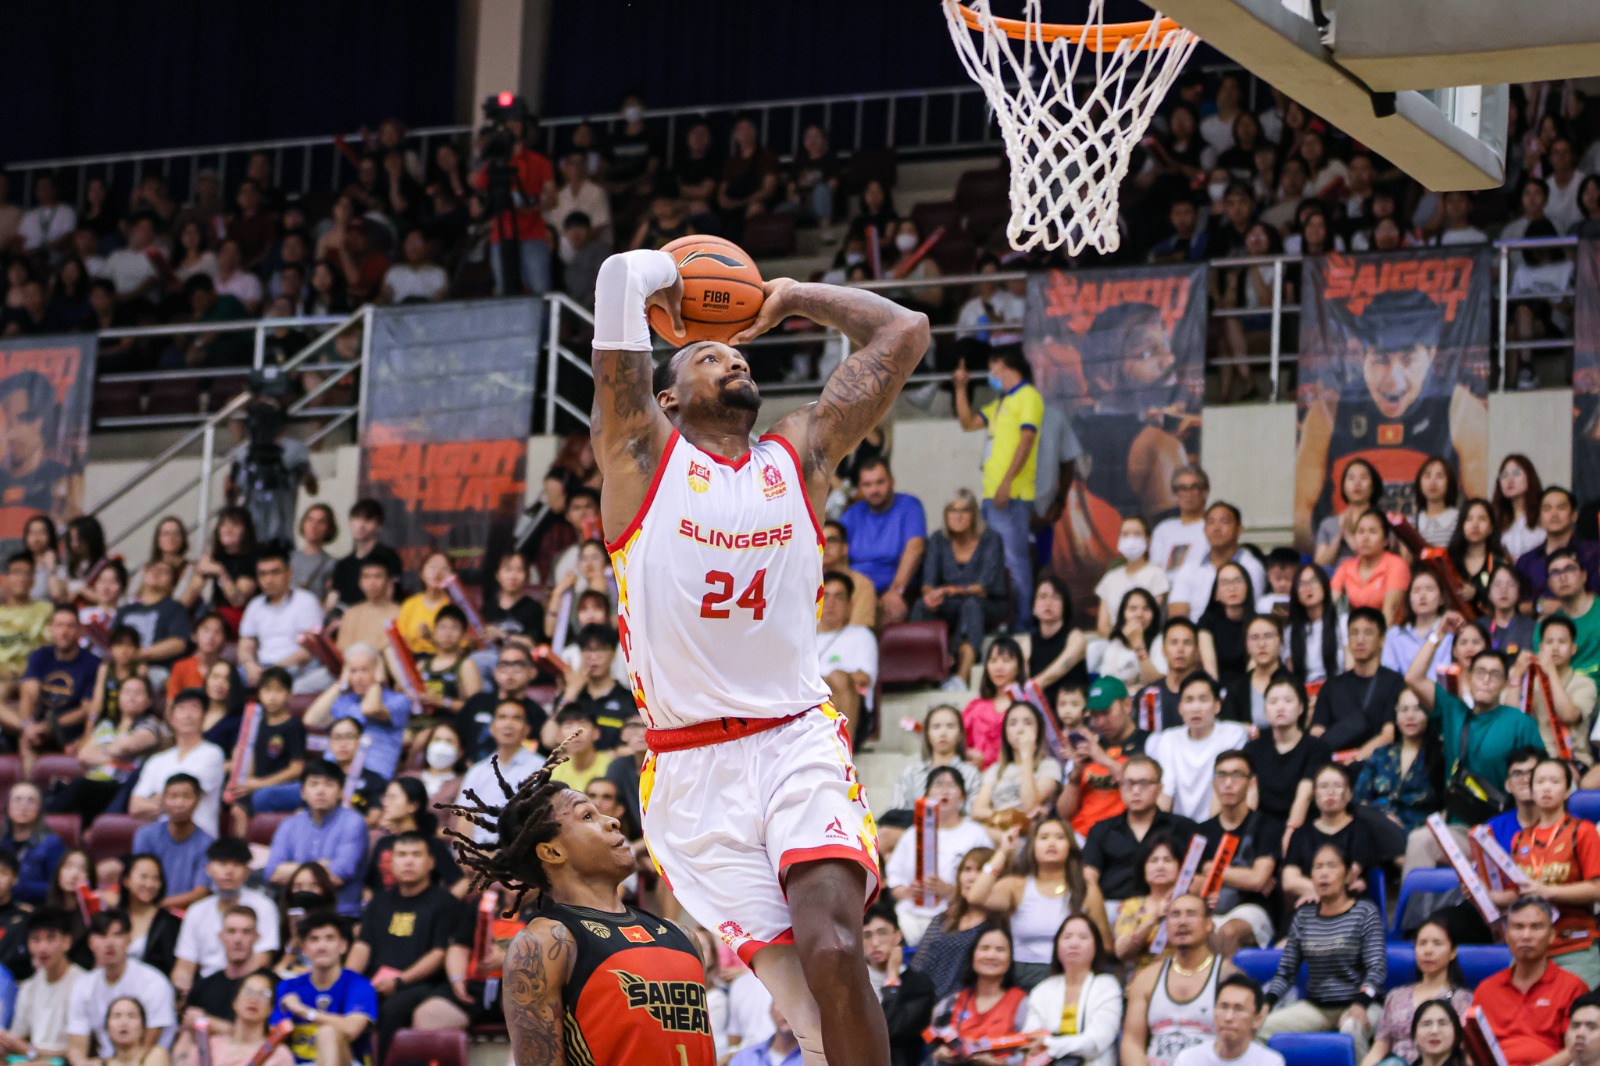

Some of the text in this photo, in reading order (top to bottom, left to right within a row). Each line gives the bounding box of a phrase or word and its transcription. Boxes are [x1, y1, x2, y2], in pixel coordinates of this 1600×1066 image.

[1323, 256, 1473, 300] SAIGON
[703, 290, 730, 304] FIBA
[368, 439, 521, 480] SAIGON
[690, 465, 710, 479] ABL
[700, 567, 767, 621] 24
[627, 981, 708, 1010] SAIGON
